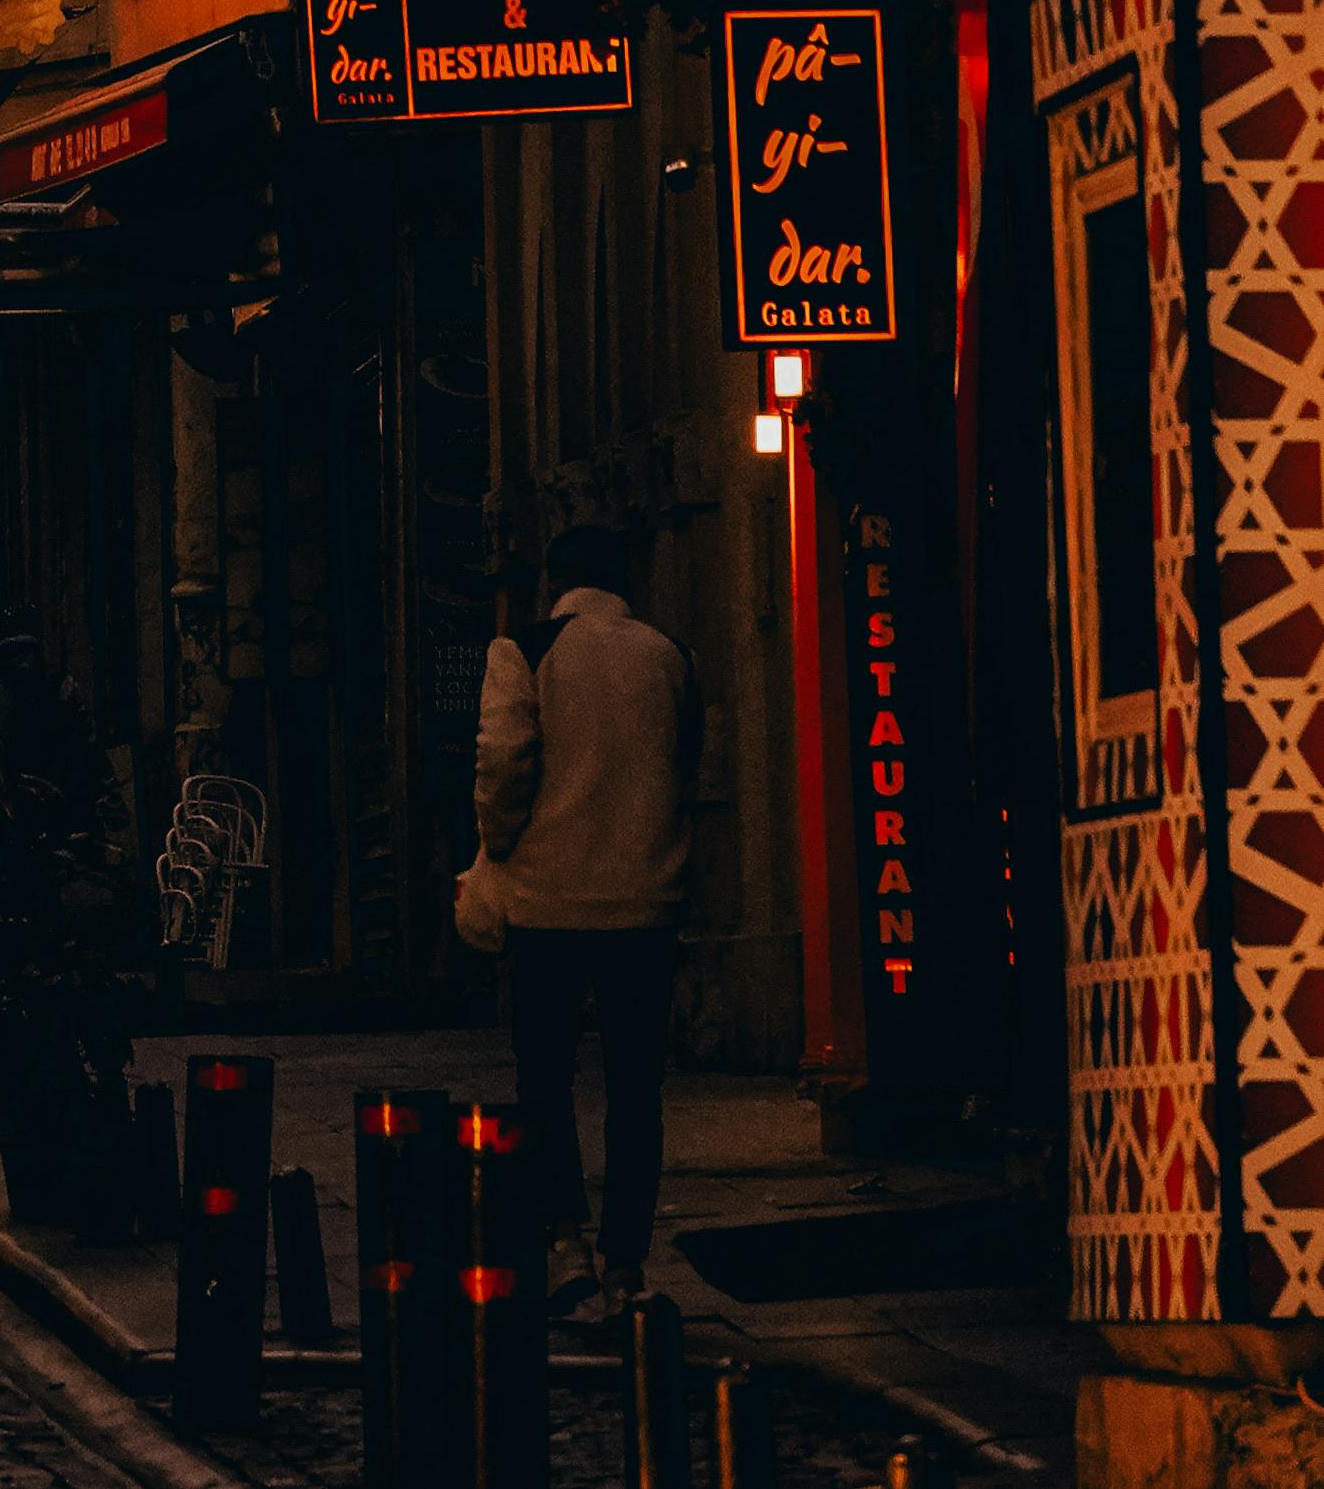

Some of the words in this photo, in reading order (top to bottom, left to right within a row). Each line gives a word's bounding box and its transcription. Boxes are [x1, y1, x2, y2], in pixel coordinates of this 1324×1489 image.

[751, 112, 849, 195] yi-
[760, 300, 873, 328] Galata
[860, 513, 915, 994] RESTAURANT
